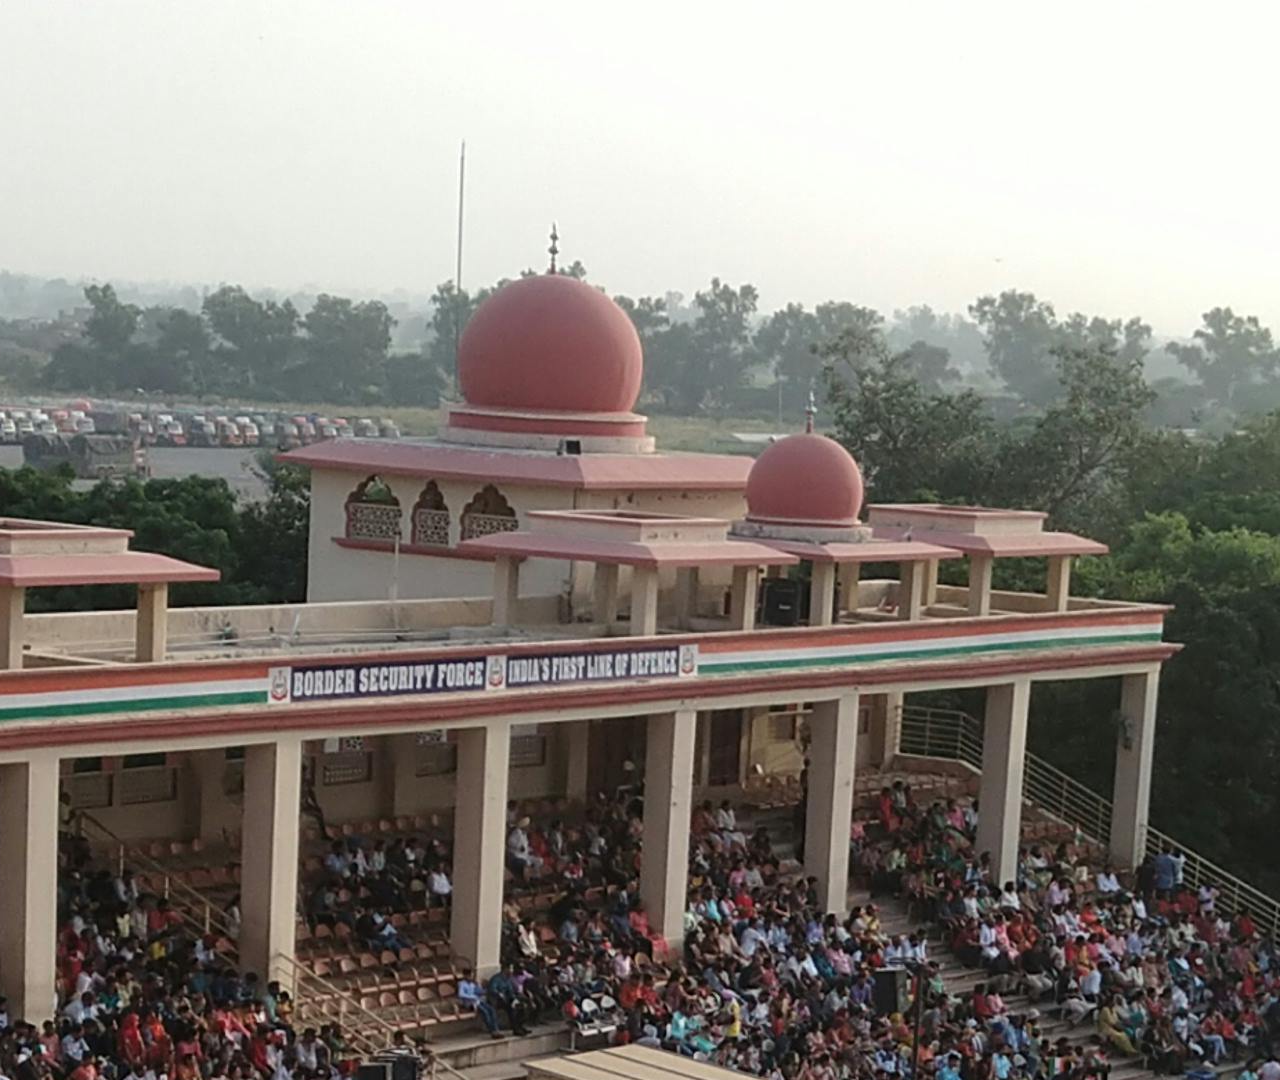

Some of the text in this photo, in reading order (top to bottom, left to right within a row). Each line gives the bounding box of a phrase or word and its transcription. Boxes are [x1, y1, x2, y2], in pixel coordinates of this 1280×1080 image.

[294, 662, 484, 697] BORDER SECURITY FORCE
[509, 651, 677, 682] INDIA'S FIRST LINE OF DEFENCE
